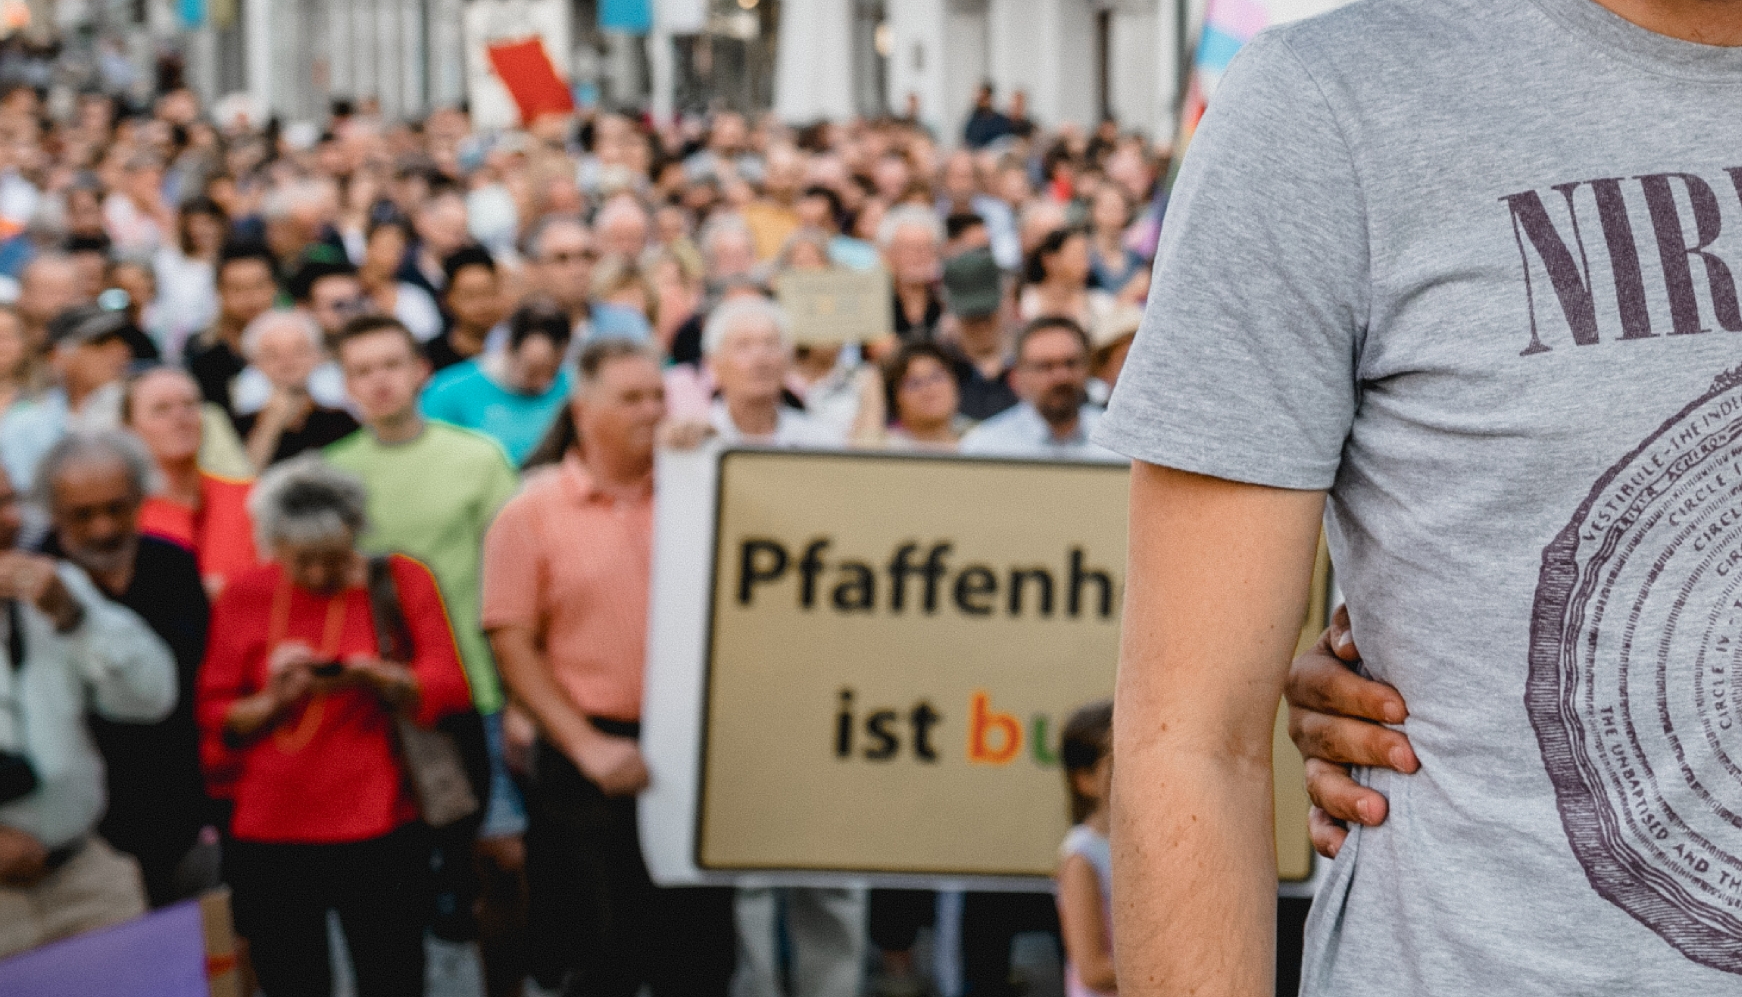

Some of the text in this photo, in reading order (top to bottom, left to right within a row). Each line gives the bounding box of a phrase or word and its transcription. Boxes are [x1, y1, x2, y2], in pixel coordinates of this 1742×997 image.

[1669, 474, 1726, 527] CIRCLE
[736, 536, 1122, 621] Pfaffenh
[836, 688, 942, 764] ist
[1711, 665, 1733, 730] CIRCLE
[1600, 706, 1618, 737] THE
[1611, 743, 1669, 840] UNBAPTISED
[1673, 843, 1709, 873] AND
